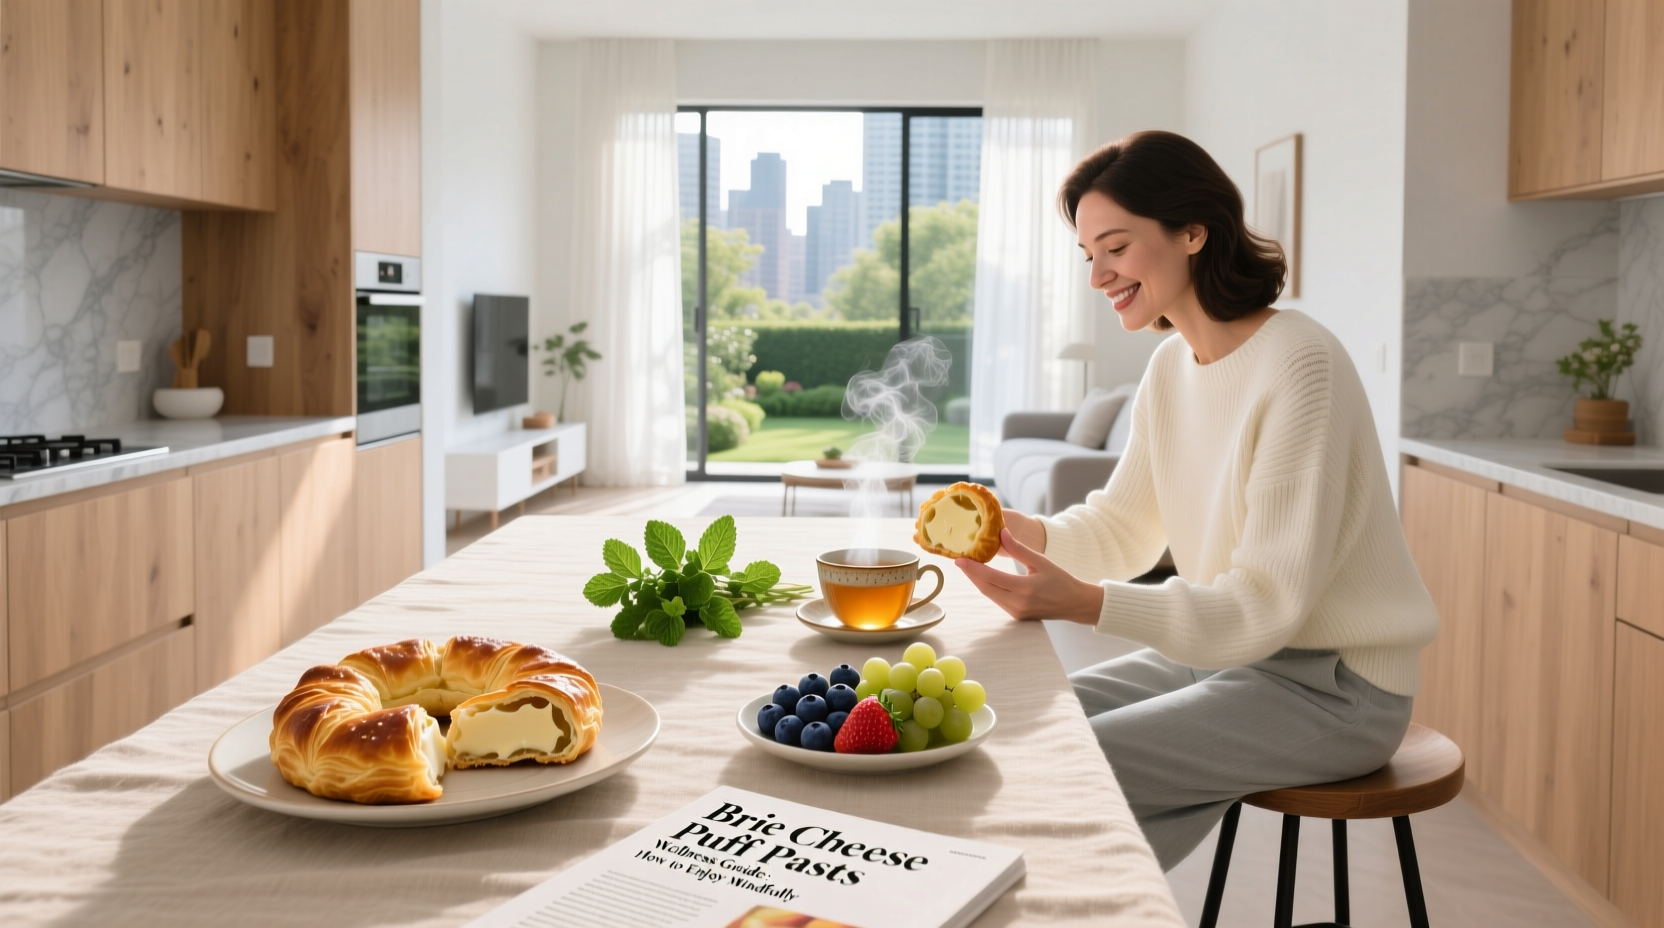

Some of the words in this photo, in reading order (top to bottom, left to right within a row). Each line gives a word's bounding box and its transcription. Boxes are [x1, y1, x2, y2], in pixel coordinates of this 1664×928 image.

[669, 821, 766, 857] Puff
[757, 844, 866, 886] Pasts
[702, 802, 786, 836] Brie
[789, 826, 929, 871] Cheese
